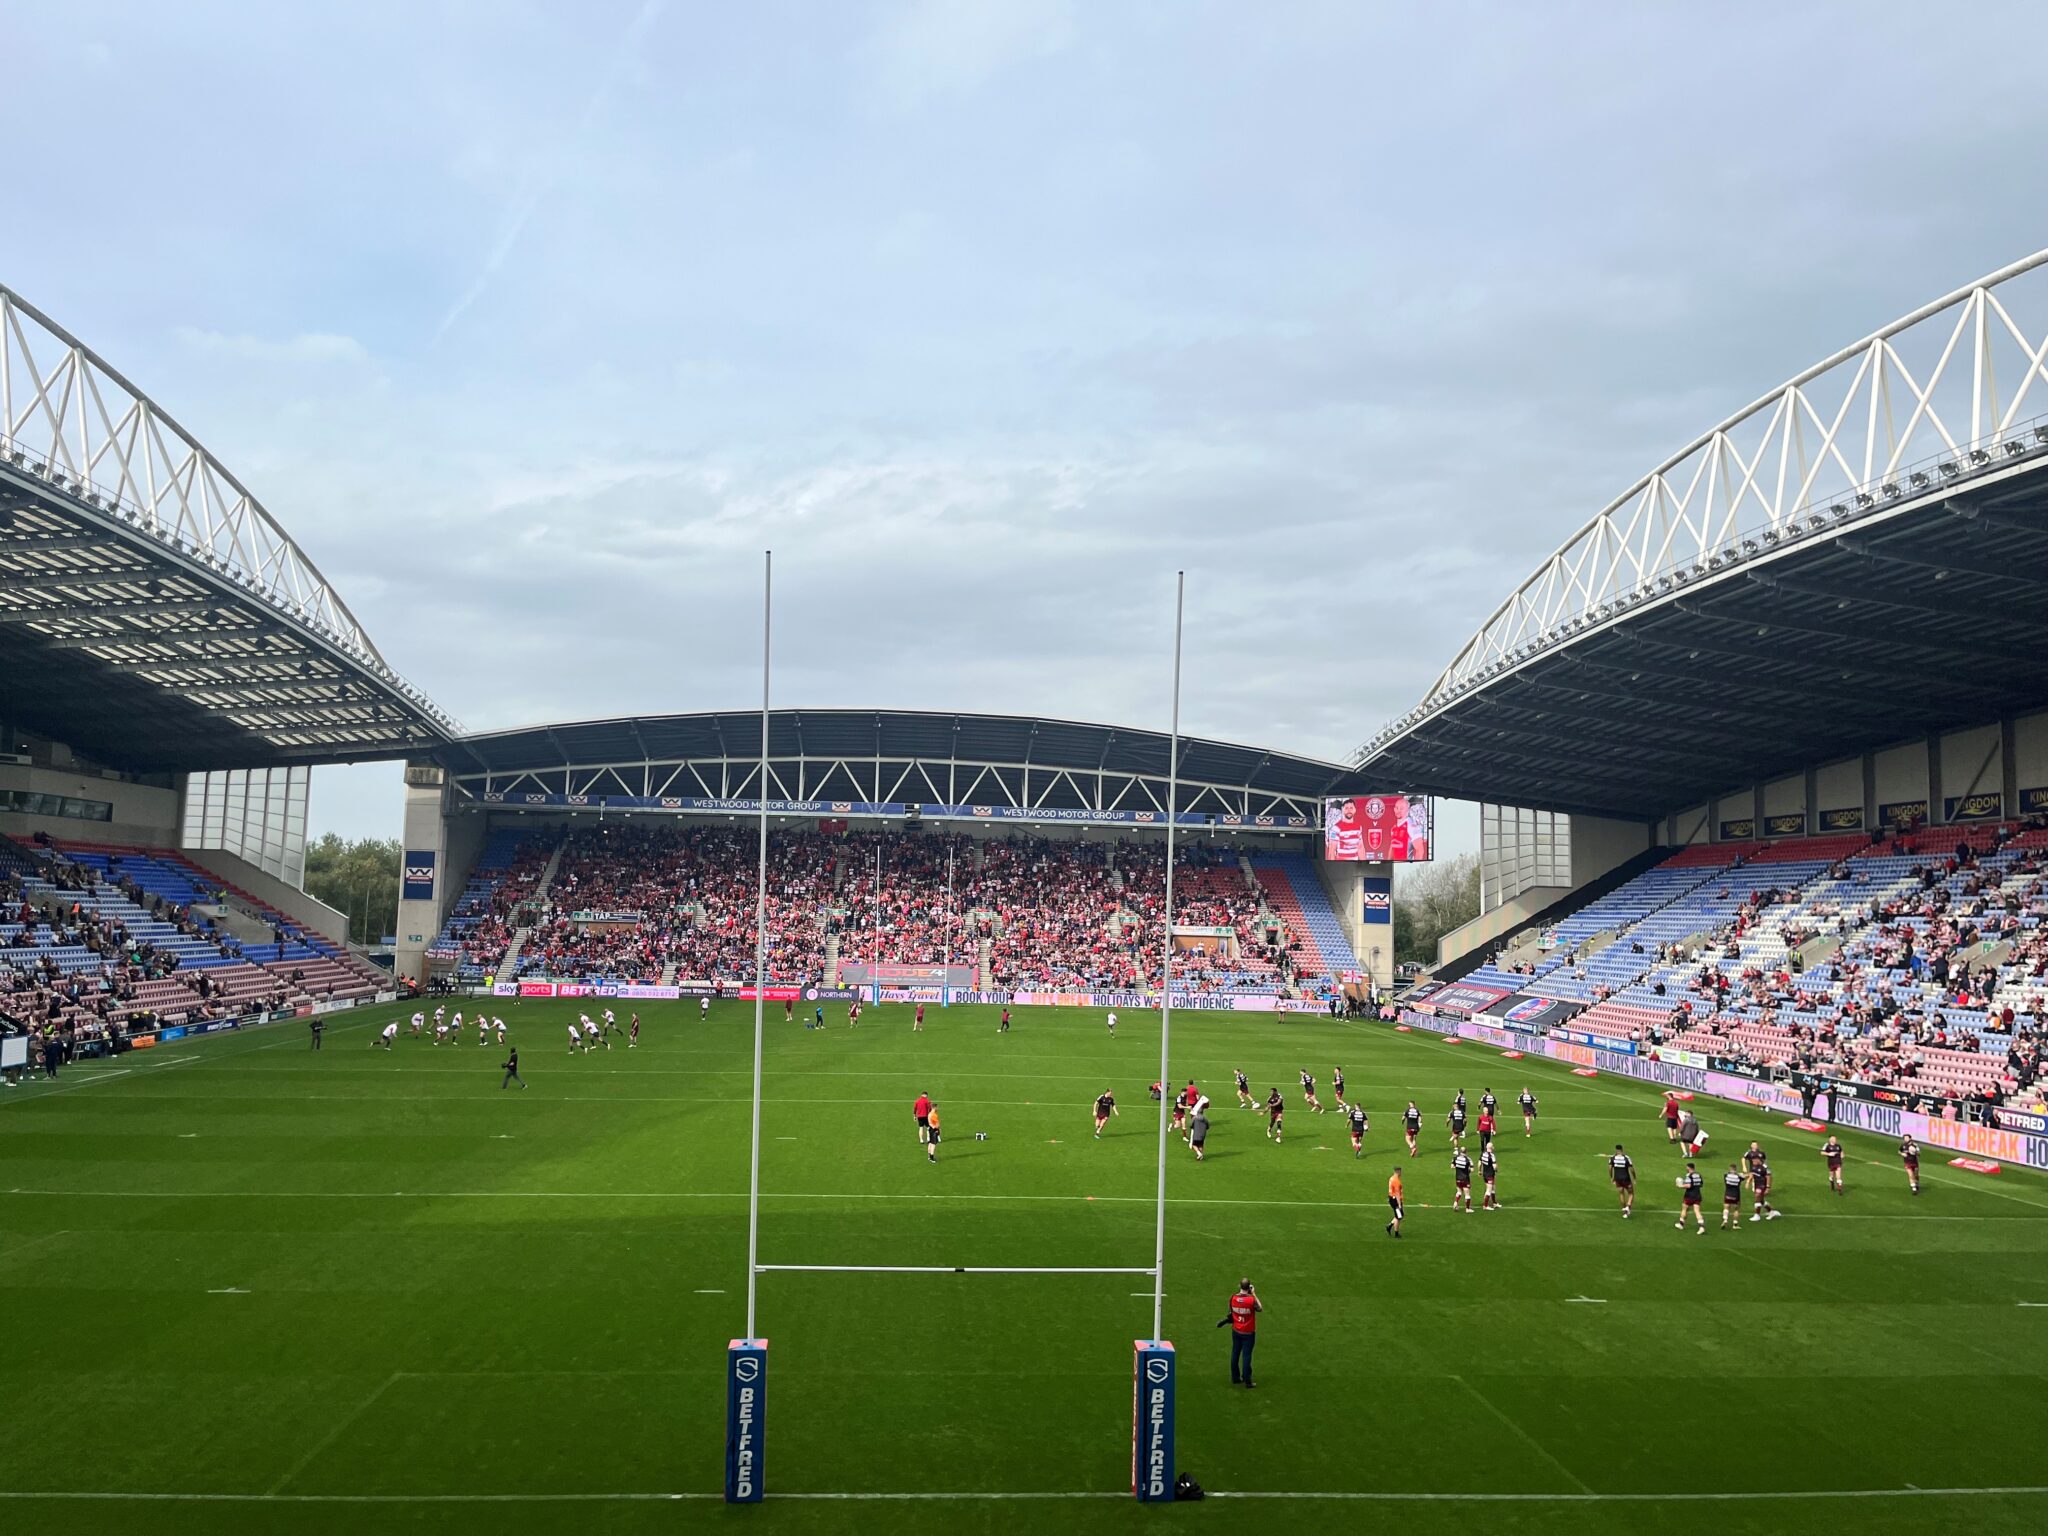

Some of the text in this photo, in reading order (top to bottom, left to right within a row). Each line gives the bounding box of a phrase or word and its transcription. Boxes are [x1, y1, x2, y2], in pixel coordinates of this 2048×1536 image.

[693, 799, 749, 809] WESTWOOD
[787, 801, 821, 811] GROUP
[1887, 803, 1927, 816] KINGDOM
[1003, 808, 1125, 820] WESTWOOD MOTOR GROUP
[498, 984, 551, 995] sky ports
[880, 990, 939, 999] Hays Travel
[956, 991, 982, 1003] BOOK
[1094, 994, 1140, 1007] HOLIDAYS
[1173, 996, 1235, 1009] CONFIDENCE
[1301, 1001, 1328, 1009] Trave
[1514, 1034, 1529, 1051] BOOK
[1530, 1036, 1546, 1055] YOUR
[1595, 1049, 1629, 1074] HOLIDAYS
[1632, 1056, 1652, 1079] WITH
[1654, 1061, 1707, 1091] CONFIDENCE
[1746, 1083, 1771, 1101] Hays
[1774, 1088, 1804, 1108] Trave
[1836, 1098, 1862, 1126] OOK
[1866, 1105, 1901, 1135] YOUR
[1928, 1118, 1962, 1148] CITY
[1967, 1125, 2019, 1161] BREAK
[737, 1387, 754, 1498] BETFRED
[1149, 1388, 1165, 1496] BETFRED
